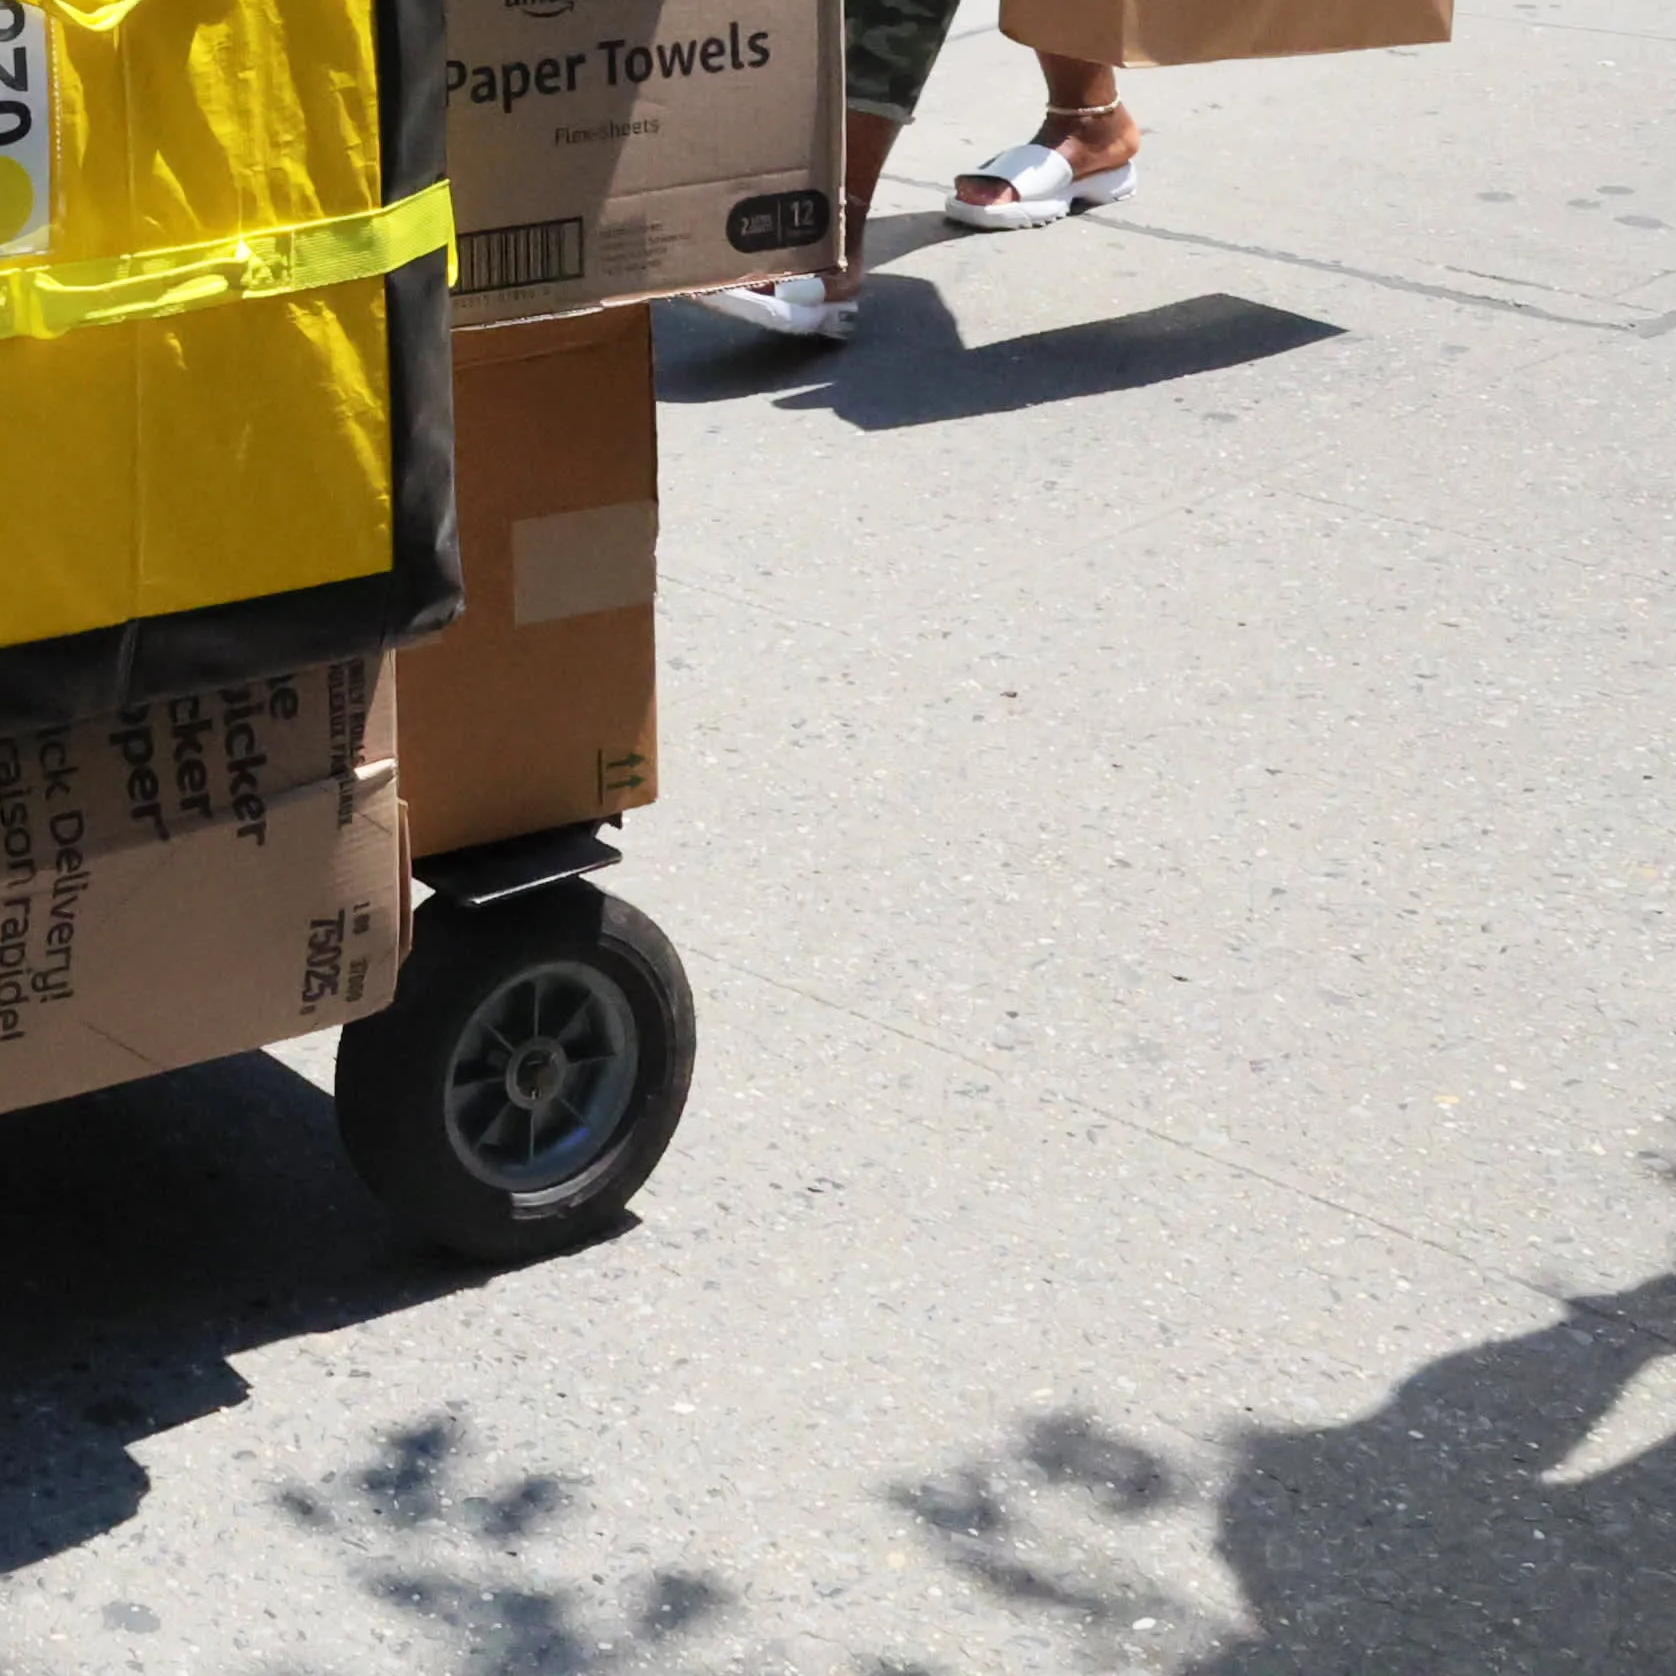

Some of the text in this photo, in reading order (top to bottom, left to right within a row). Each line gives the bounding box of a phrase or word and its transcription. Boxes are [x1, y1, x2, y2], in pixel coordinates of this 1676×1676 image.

[445, 22, 772, 113] Paper Towels
[109, 702, 170, 842] per
[168, 695, 214, 819] cker
[219, 687, 269, 847] icker
[30, 728, 90, 1004] ick Delivery!
